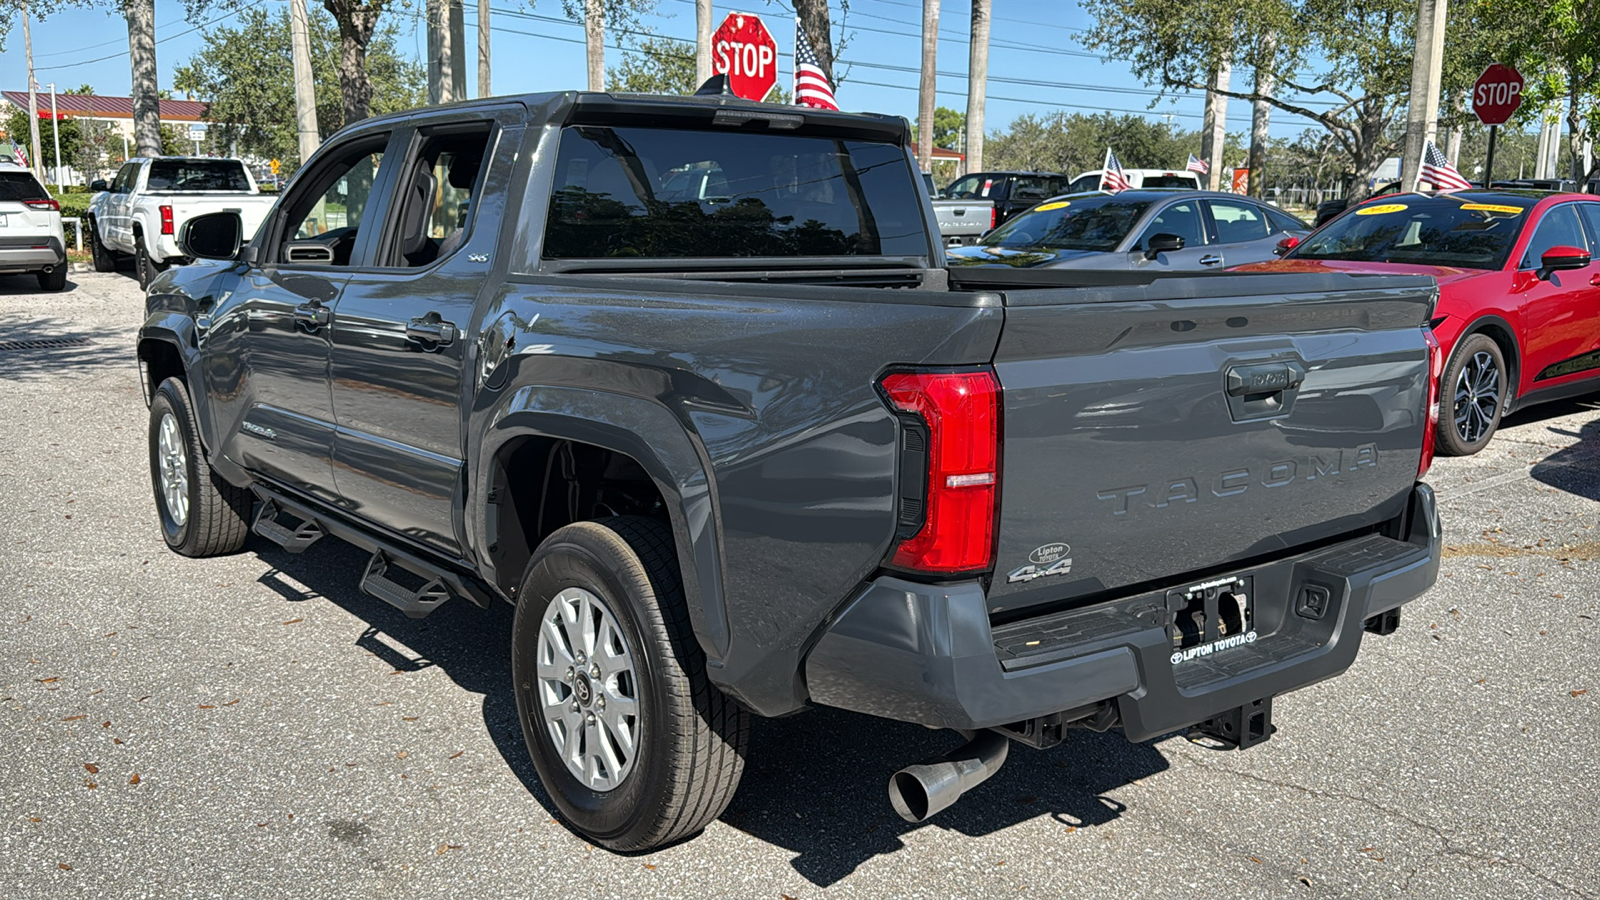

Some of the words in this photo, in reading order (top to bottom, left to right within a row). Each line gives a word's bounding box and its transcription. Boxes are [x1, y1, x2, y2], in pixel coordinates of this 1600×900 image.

[715, 40, 773, 78] STOP
[1475, 81, 1520, 107] STOP
[1251, 372, 1286, 386] TOYOTA
[1097, 442, 1378, 515] TACOMA
[1038, 545, 1063, 557] Lipton
[1039, 553, 1060, 562] TOYOTA
[1006, 558, 1072, 584] 4x4
[1183, 643, 1213, 661] LIPTON
[1214, 634, 1246, 651] TOYOTA
